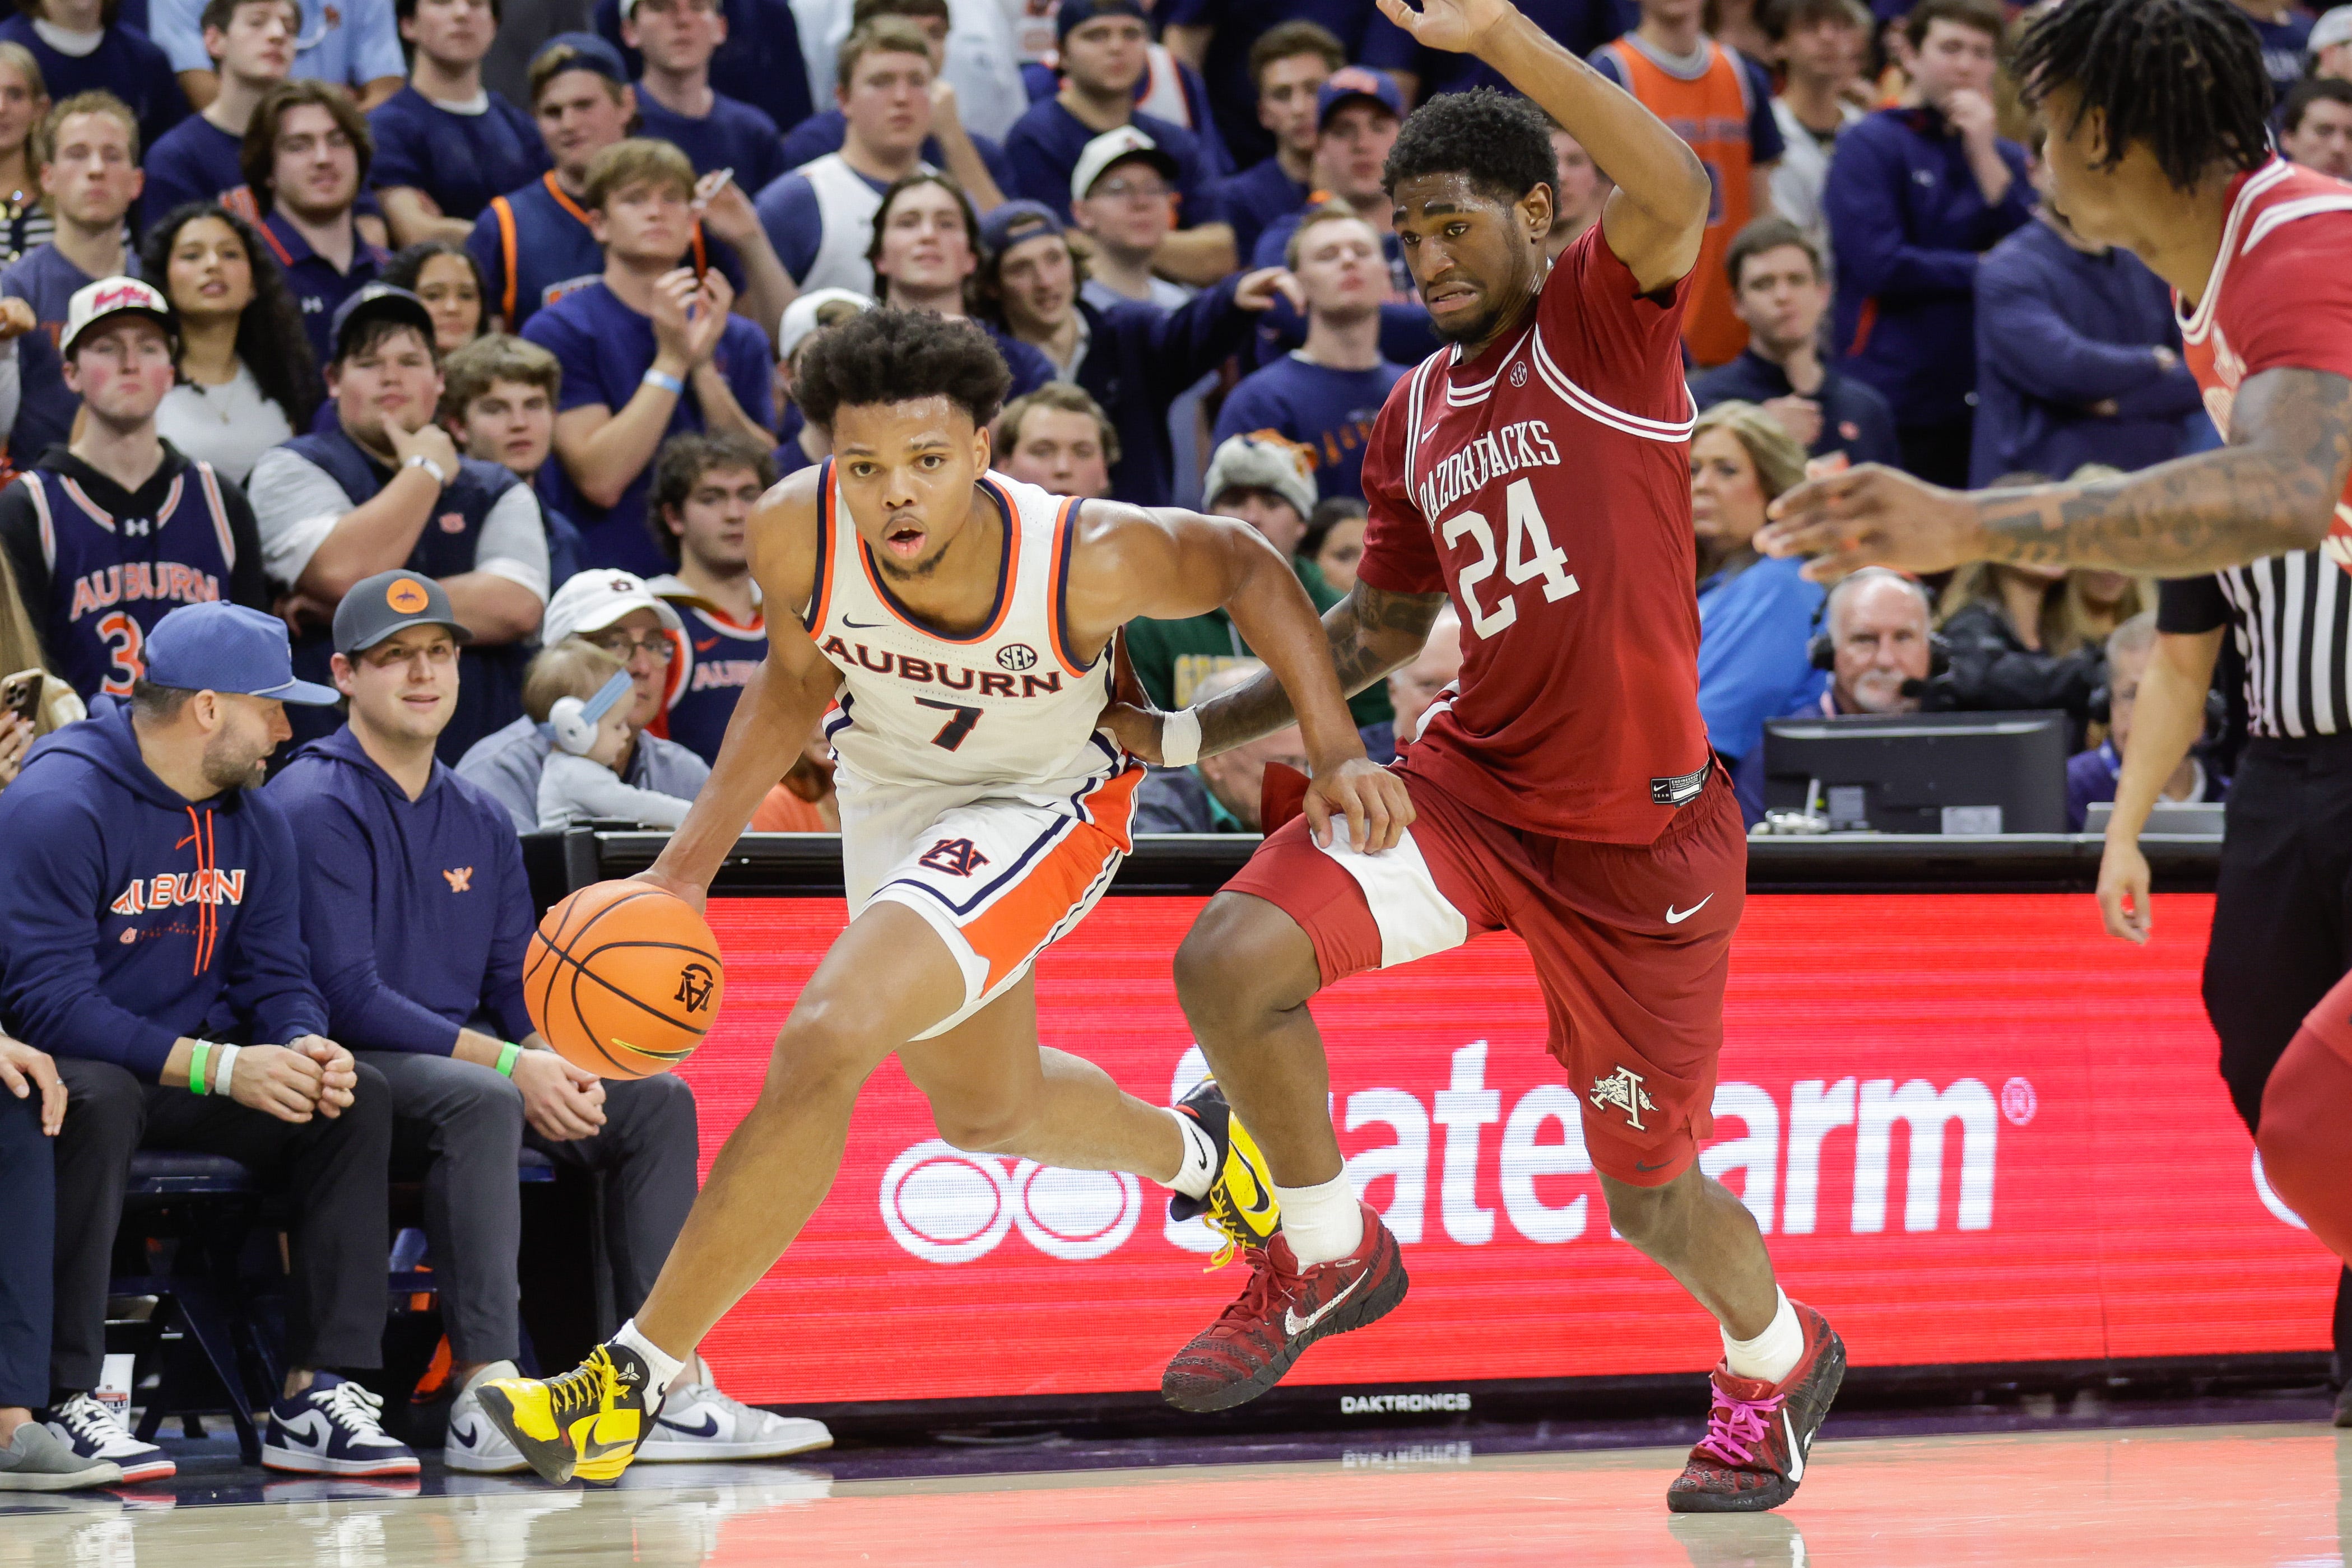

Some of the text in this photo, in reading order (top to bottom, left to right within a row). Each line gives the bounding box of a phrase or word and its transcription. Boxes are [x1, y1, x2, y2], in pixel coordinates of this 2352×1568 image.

[1510, 361, 1527, 388] SEC
[1442, 477, 1581, 640] 24
[69, 561, 220, 622] AUBURN
[820, 635, 1063, 699] AUBURN
[996, 643, 1039, 671] SEC
[913, 695, 984, 753] 7
[1610, 1076, 1998, 1239] arm
[1340, 1393, 1472, 1415] DAKTRONICS
